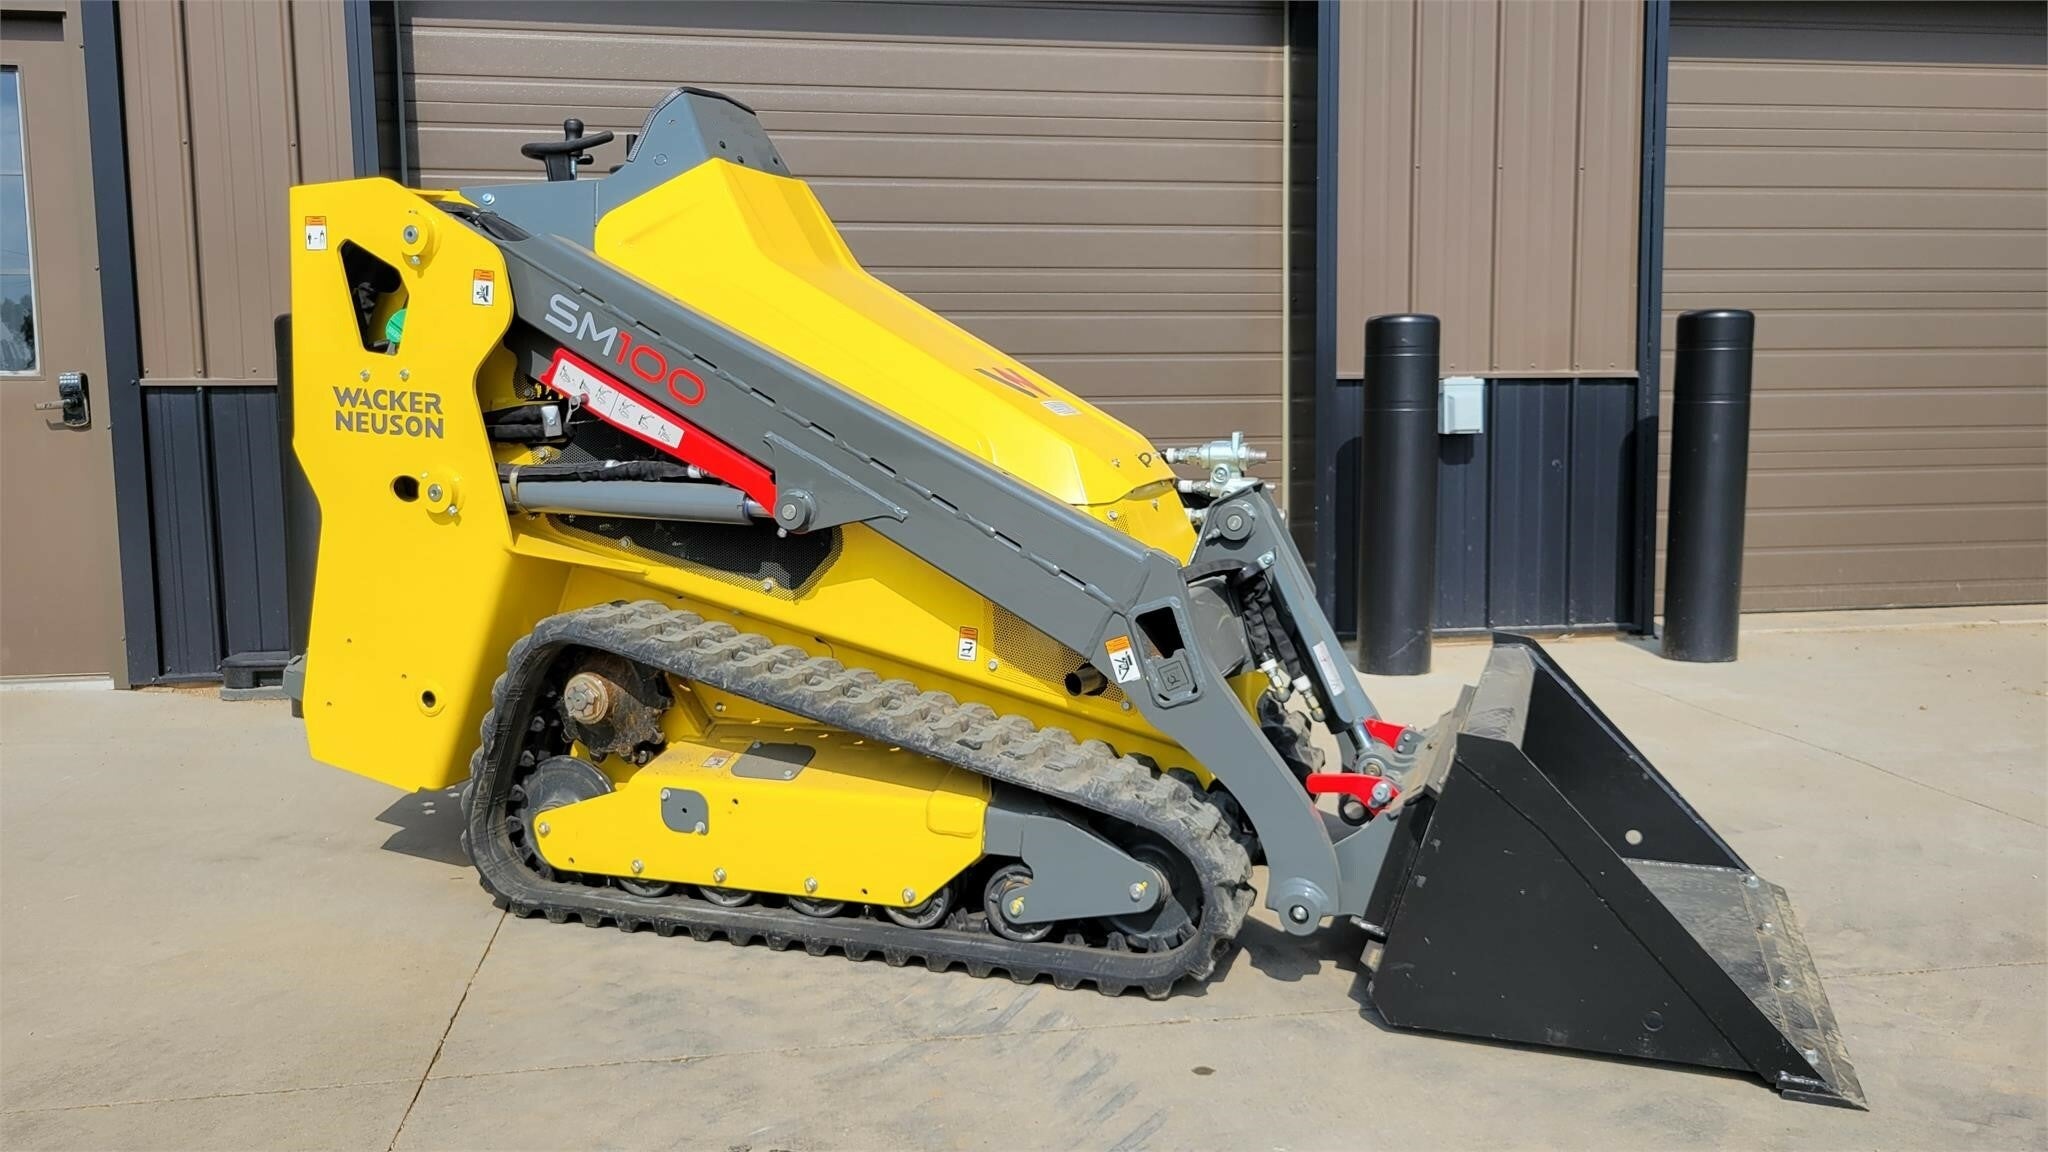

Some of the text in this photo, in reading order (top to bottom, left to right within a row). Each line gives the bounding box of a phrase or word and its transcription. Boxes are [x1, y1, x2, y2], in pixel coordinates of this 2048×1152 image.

[545, 293, 706, 407] SM100
[333, 385, 443, 415] WACKER
[336, 410, 444, 439] NEUSON
